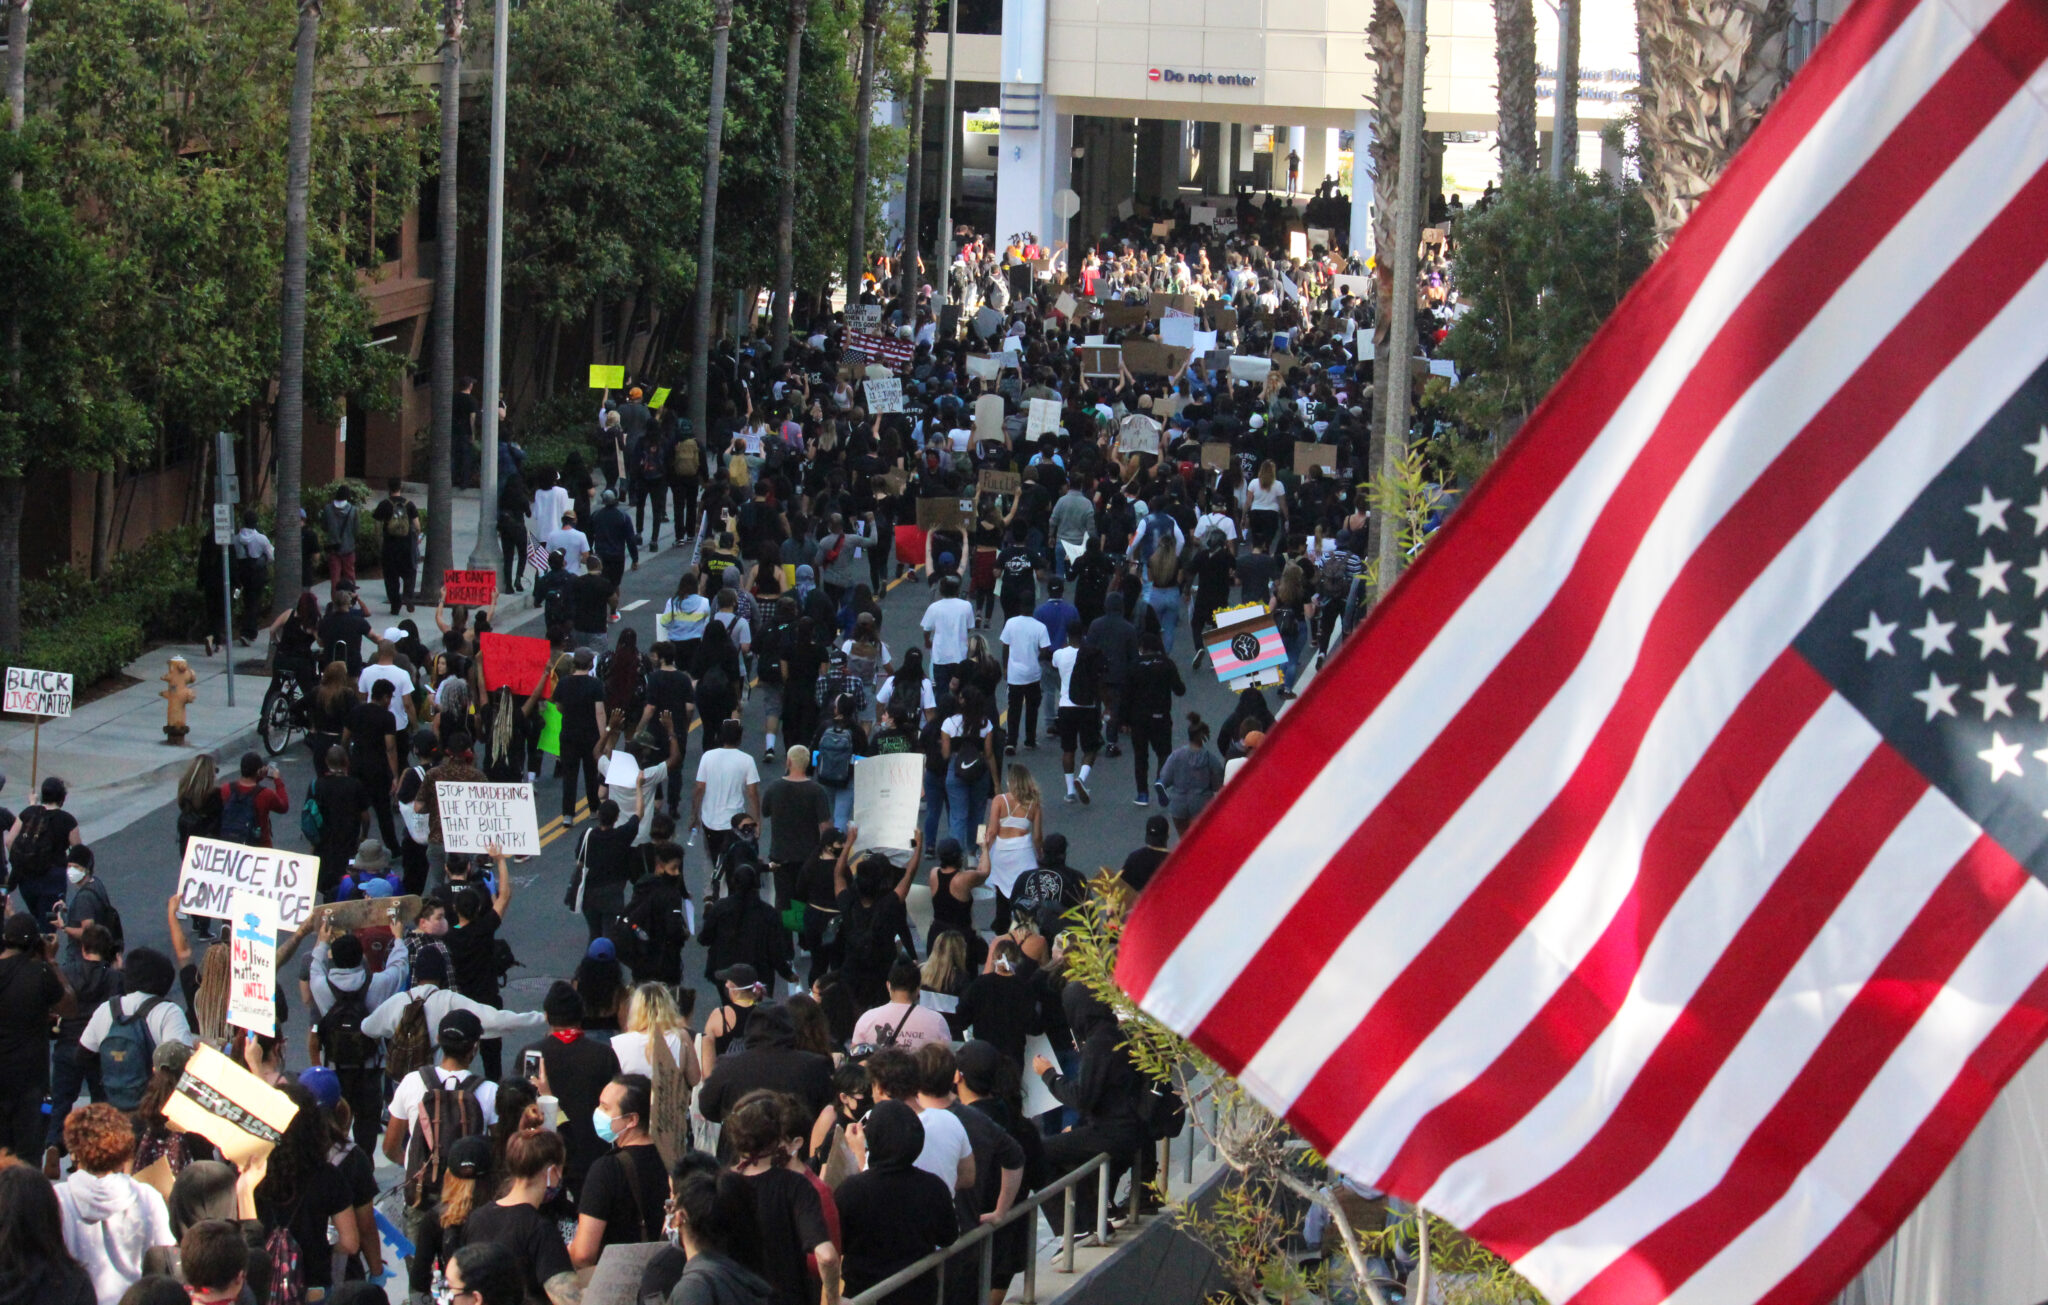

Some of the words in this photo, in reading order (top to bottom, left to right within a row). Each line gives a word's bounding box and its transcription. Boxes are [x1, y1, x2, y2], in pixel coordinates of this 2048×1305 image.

[1164, 69, 1184, 82] Do
[1188, 73, 1213, 84] not
[1217, 74, 1256, 86] enter
[7, 669, 69, 693] BLACK
[5, 691, 38, 712] LIVES
[38, 693, 71, 715] MATTER
[438, 784, 464, 797] STOP
[468, 785, 529, 801] MURDERING
[441, 800, 461, 816] THE
[465, 800, 511, 817] PEOPLE
[443, 816, 469, 832] THAT
[478, 817, 512, 832] BUILT
[447, 834, 469, 848] THIS
[191, 843, 270, 886] SILENCE
[274, 859, 300, 888] IS
[181, 877, 310, 925] COMPCE
[234, 939, 248, 961] No
[249, 940, 270, 968] lives
[233, 962, 260, 982] matter
[243, 982, 270, 1002] UNTIL
